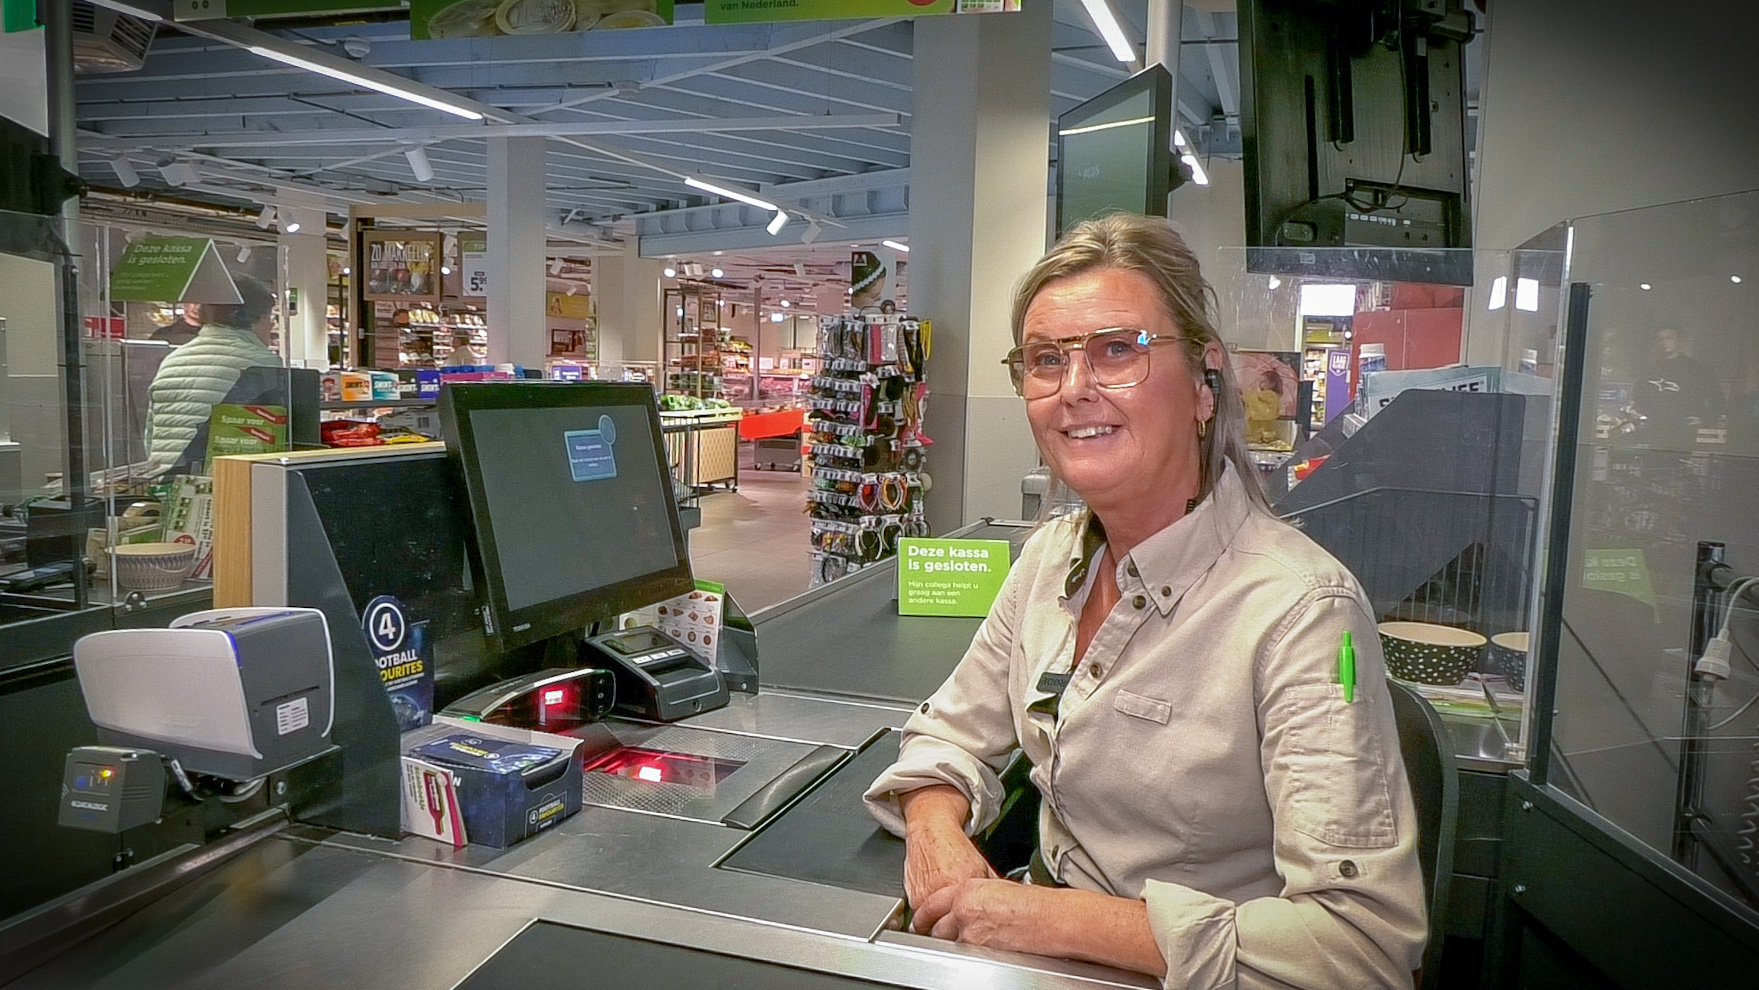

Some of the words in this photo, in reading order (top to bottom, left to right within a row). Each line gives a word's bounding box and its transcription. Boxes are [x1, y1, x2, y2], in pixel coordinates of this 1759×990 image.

[720, 3, 739, 11] van
[741, 0, 799, 9] Nederland.
[134, 245, 160, 253] Deze
[162, 244, 192, 253] kassa
[127, 255, 137, 264] is
[139, 256, 186, 266] gesloten.
[221, 415, 245, 425] Spaar
[247, 418, 265, 426] voor
[214, 436, 238, 445] Spaar
[908, 545, 945, 557] Deze
[949, 546, 989, 558] kassa
[908, 559, 920, 570] is
[924, 560, 992, 573] gesloten.
[908, 581, 924, 589] Mijn
[925, 581, 951, 589] collega
[953, 581, 972, 590] helpt
[908, 589, 930, 597] graag
[936, 597, 959, 605] kassa.
[378, 613, 396, 640] 4
[375, 649, 418, 670] OTBALL
[380, 660, 424, 682] OURITES
